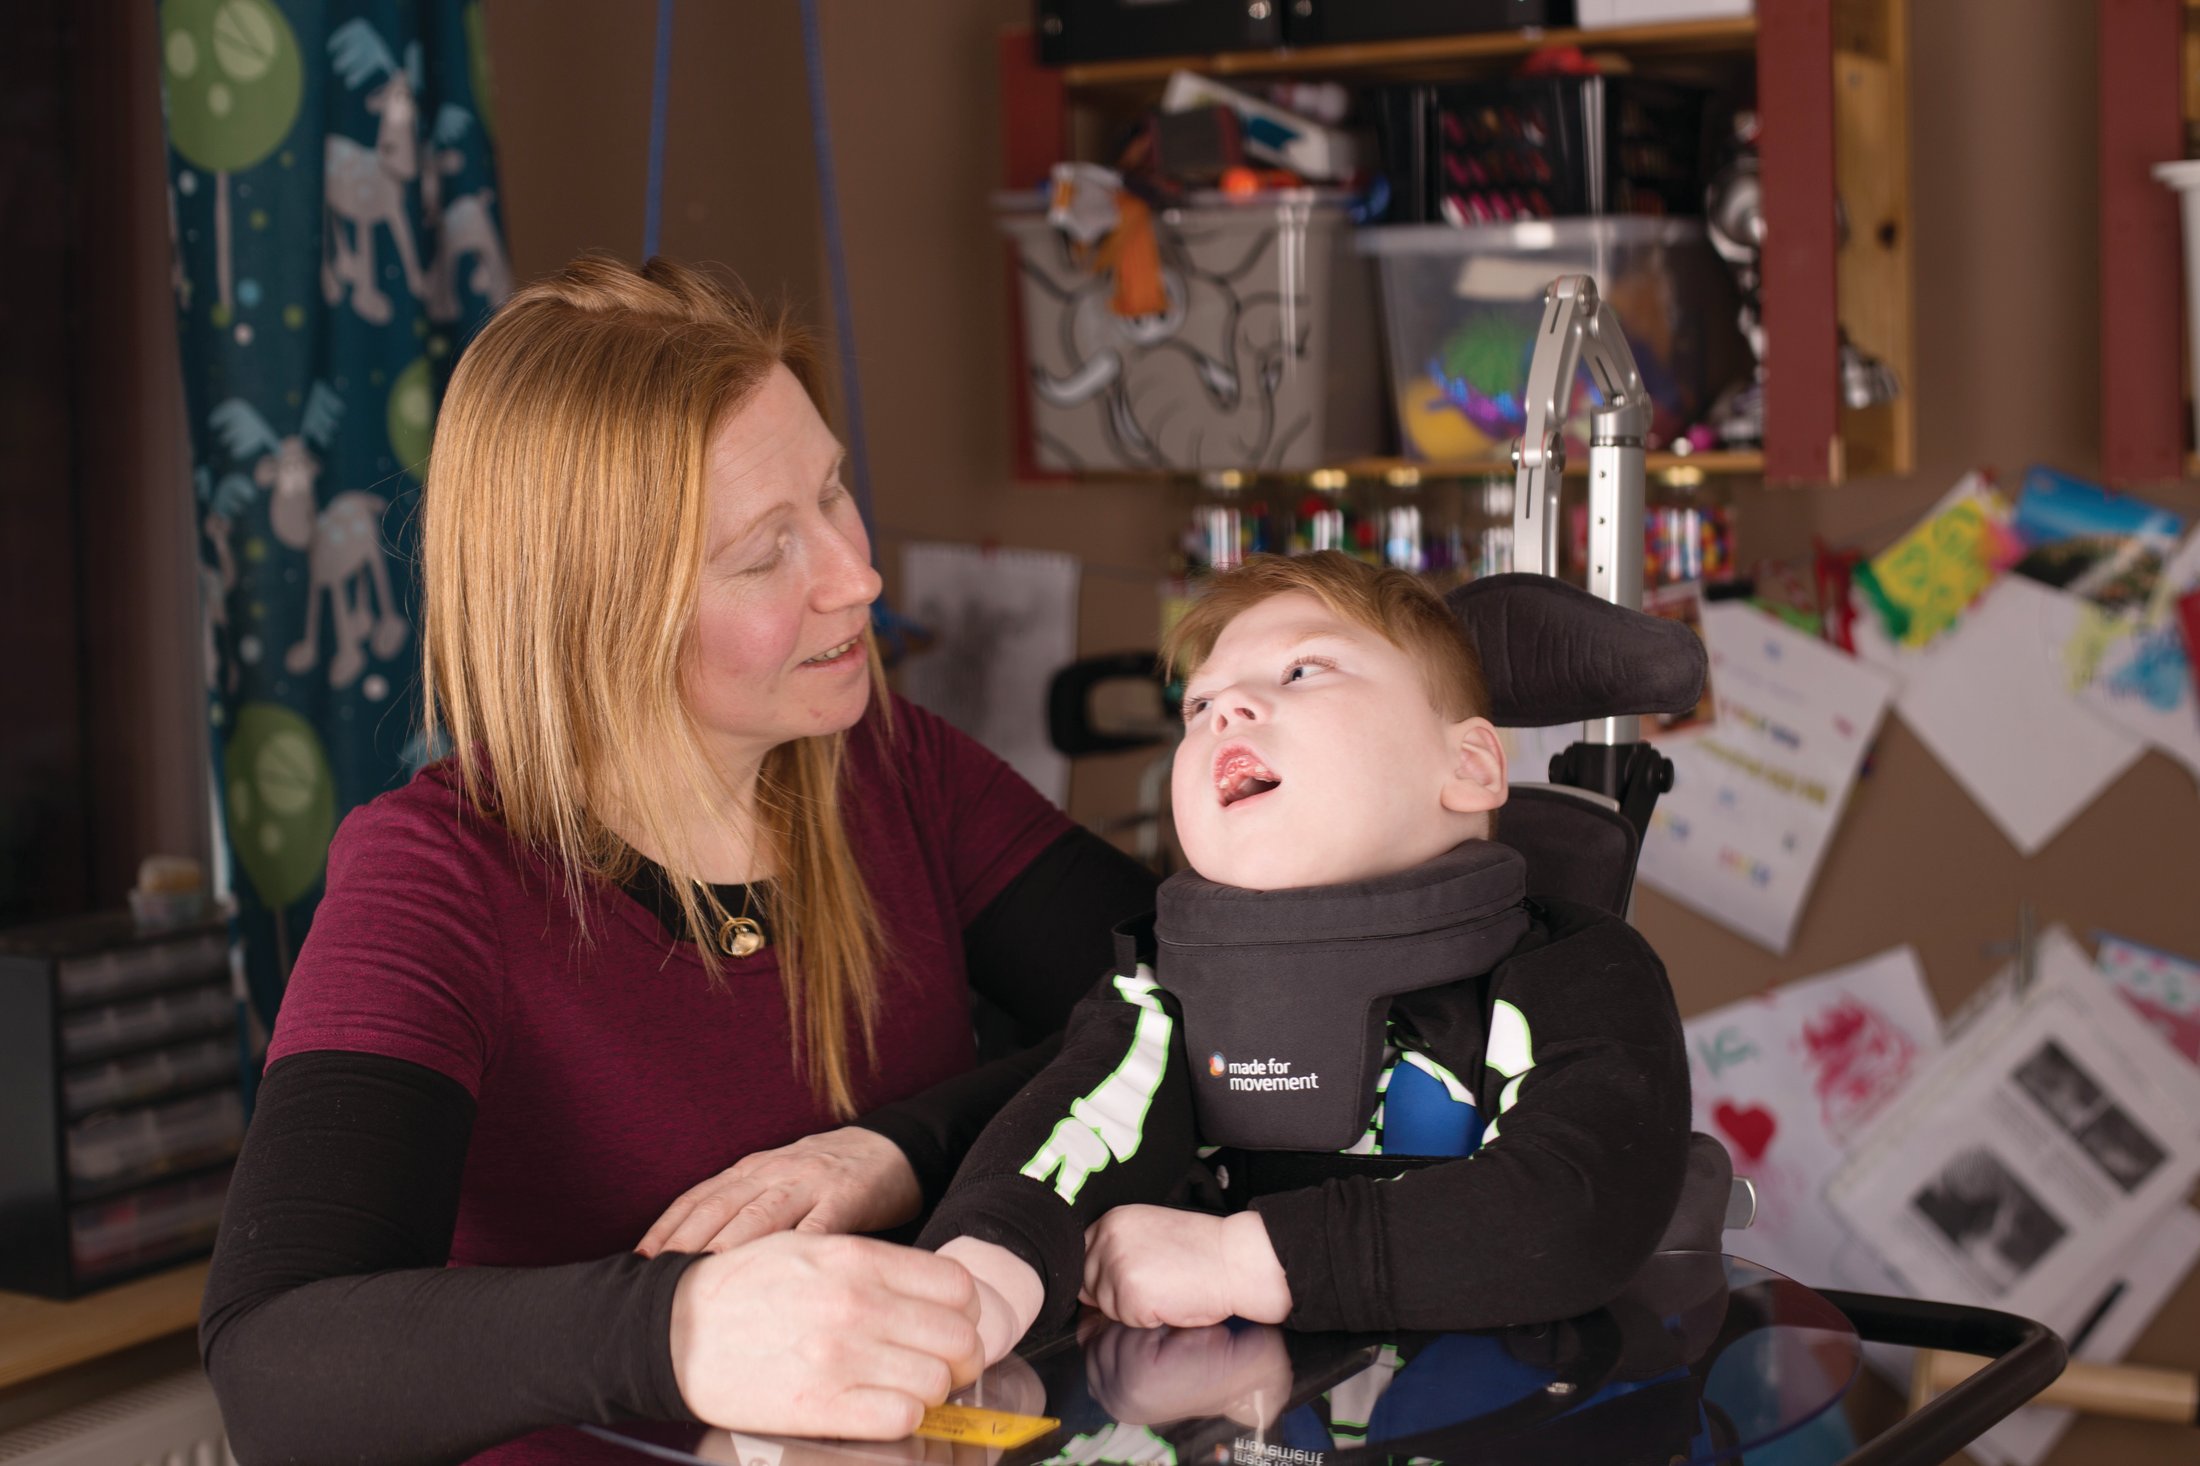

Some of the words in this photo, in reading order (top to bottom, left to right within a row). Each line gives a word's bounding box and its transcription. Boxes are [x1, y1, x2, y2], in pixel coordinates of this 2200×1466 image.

[1229, 1058, 1266, 1075] made
[1267, 1058, 1291, 1075] for
[1230, 1073, 1319, 1091] movement
